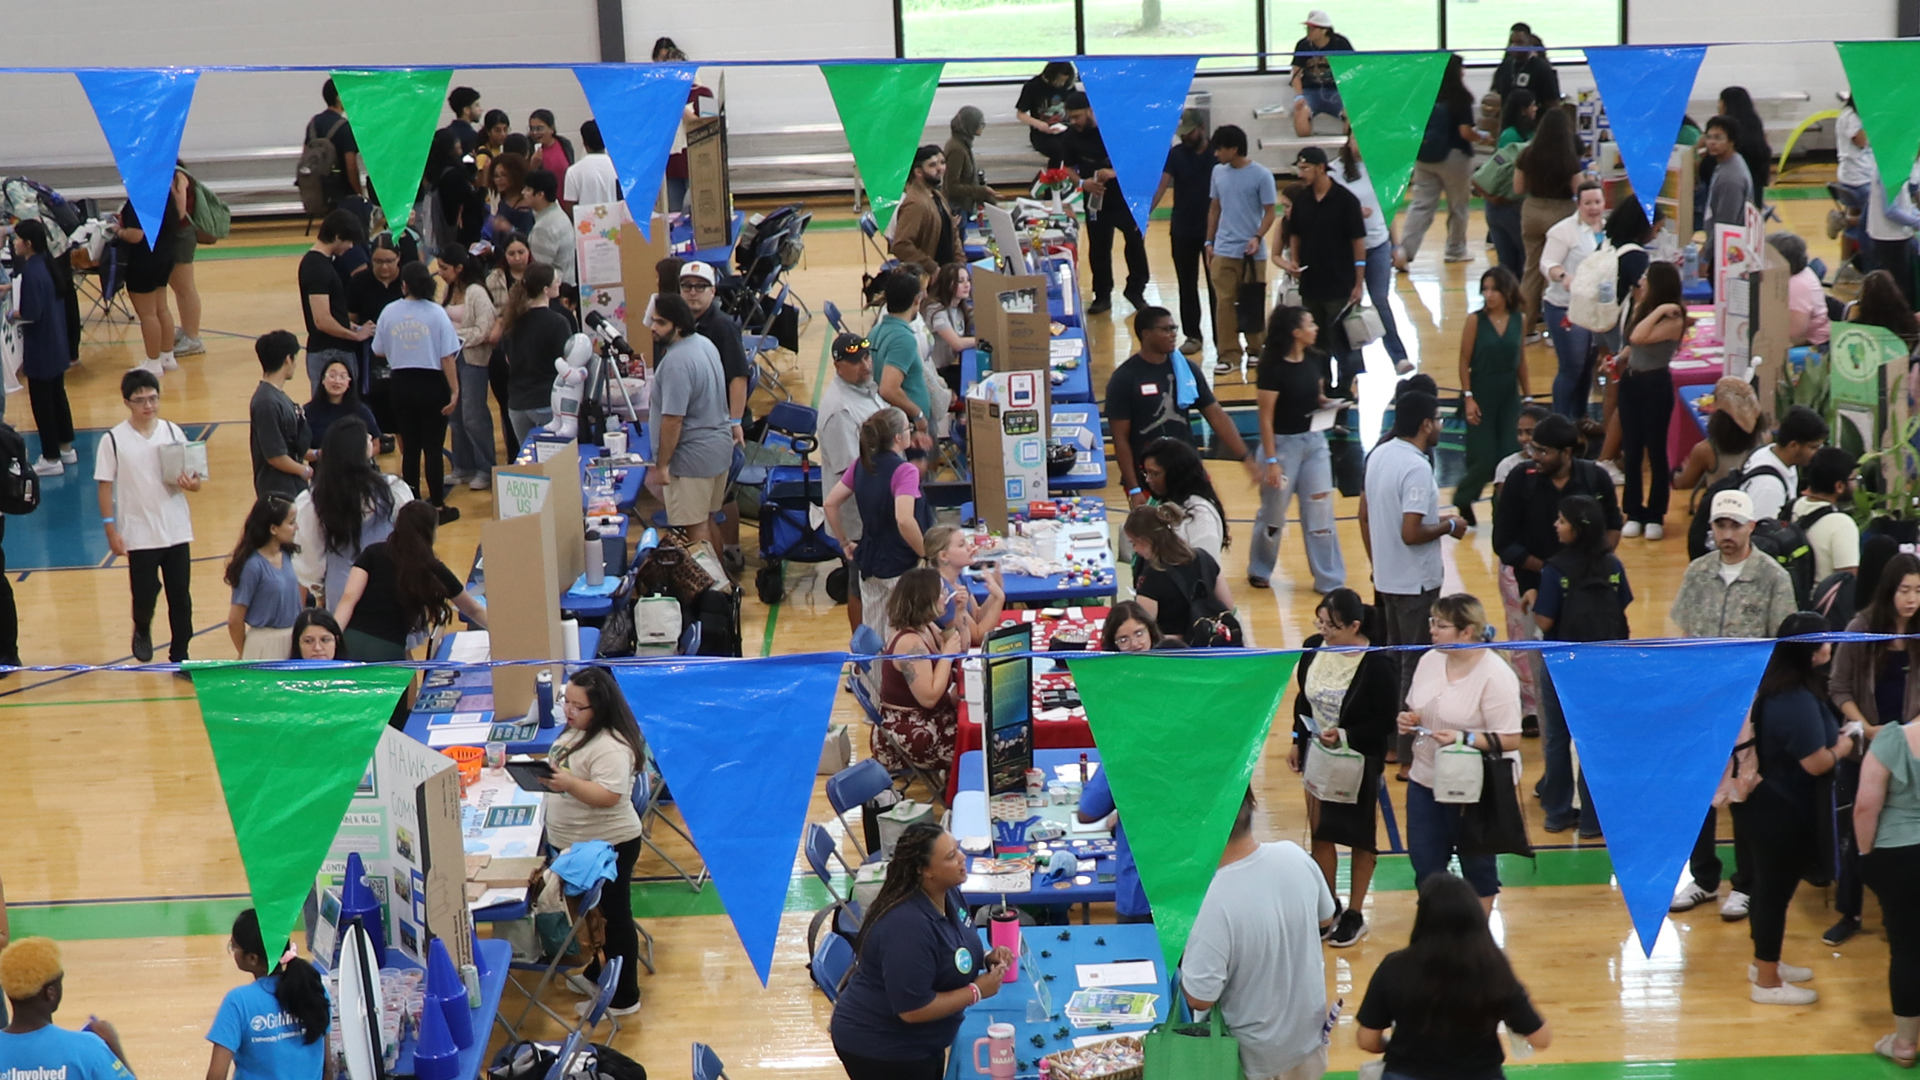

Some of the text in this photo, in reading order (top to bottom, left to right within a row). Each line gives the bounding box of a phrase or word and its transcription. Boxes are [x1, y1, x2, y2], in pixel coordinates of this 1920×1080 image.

[506, 480, 540, 499] ABOUT
[516, 498, 532, 514] US
[0, 1064, 67, 1080] etInvolved
